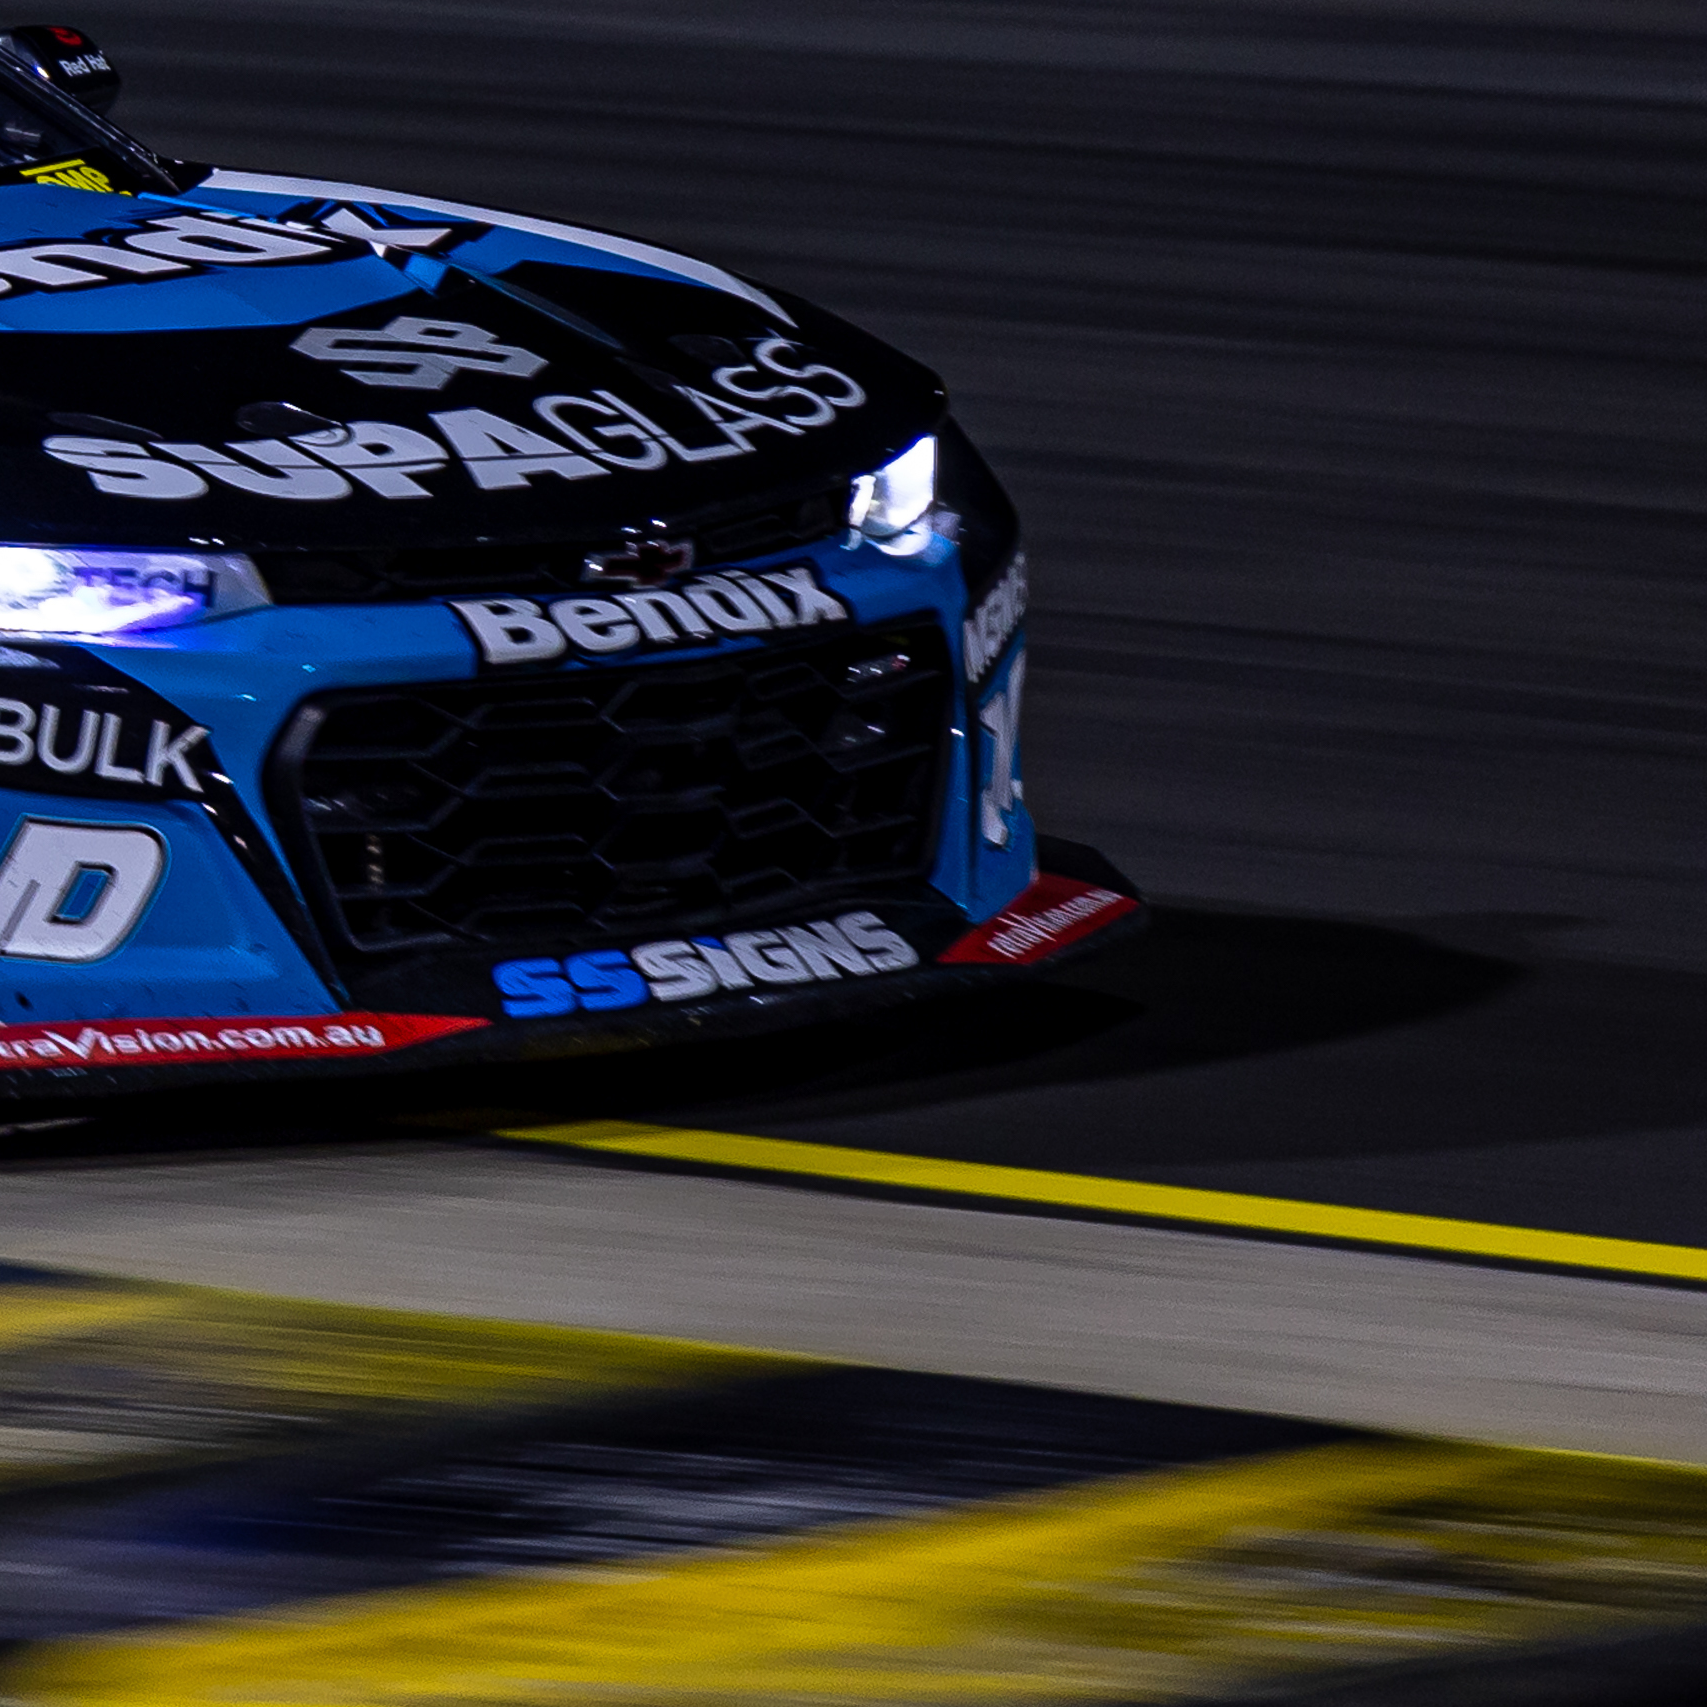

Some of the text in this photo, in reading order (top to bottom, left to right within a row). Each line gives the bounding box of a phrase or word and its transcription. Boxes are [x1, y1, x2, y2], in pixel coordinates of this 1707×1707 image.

[59, 56, 91, 77] Red
[42, 336, 866, 499] SUPAGLASS
[451, 567, 848, 665] Bendix
